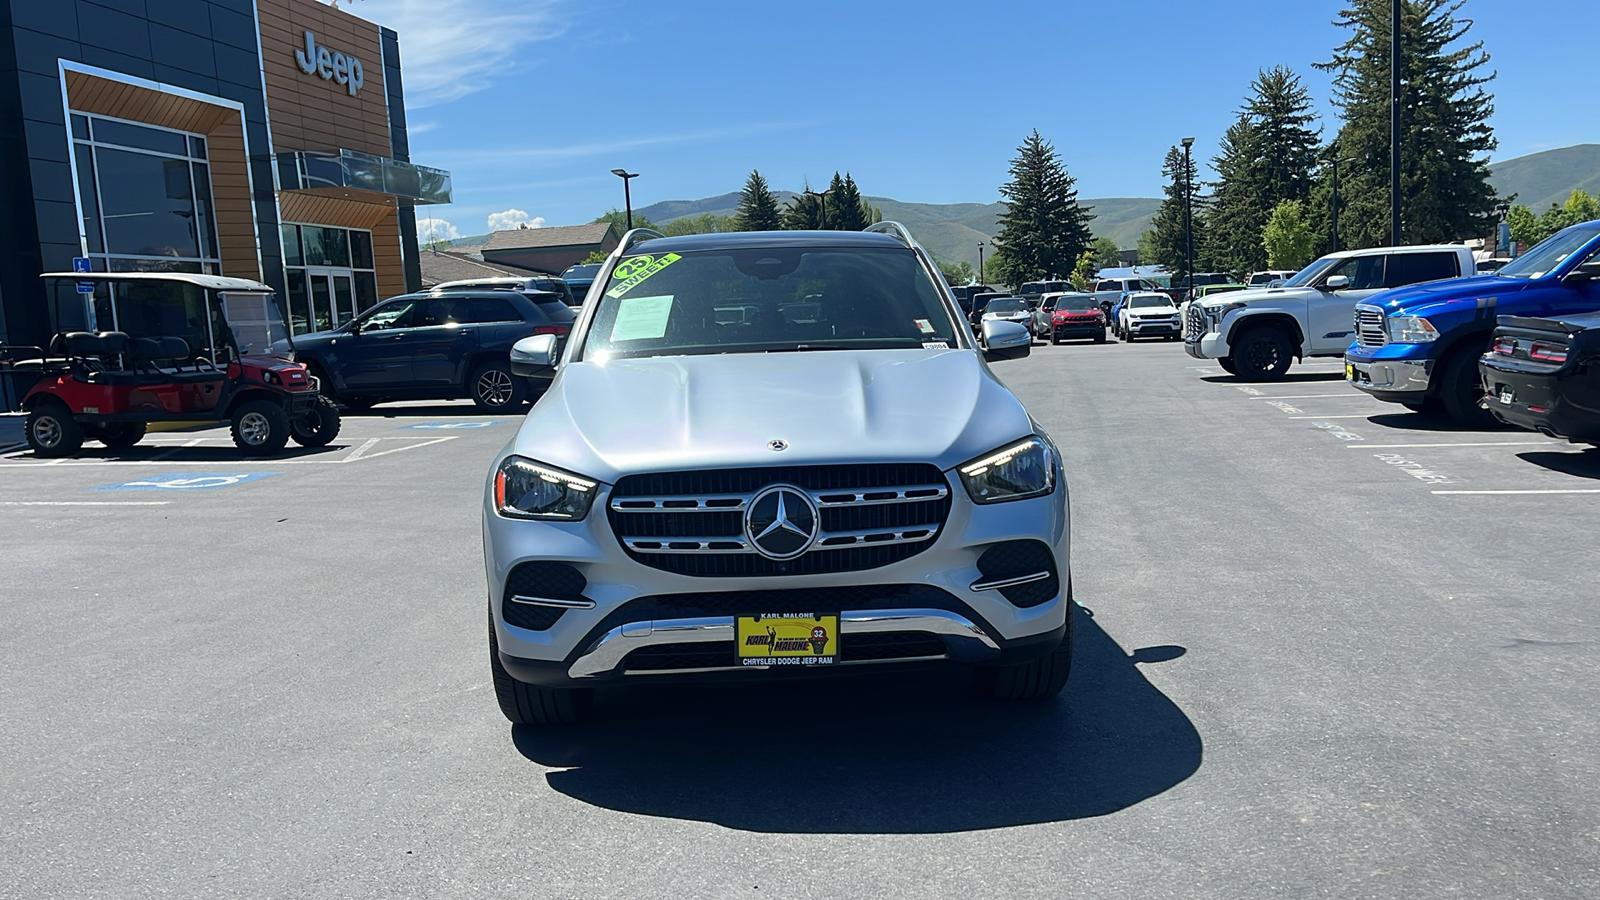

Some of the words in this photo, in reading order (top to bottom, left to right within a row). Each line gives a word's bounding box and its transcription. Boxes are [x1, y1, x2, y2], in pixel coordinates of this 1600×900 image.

[294, 30, 364, 96] Jeep
[619, 258, 647, 276] 25
[813, 630, 824, 638] 32
[745, 635, 770, 646] KARL
[774, 640, 810, 651] MALONE
[742, 658, 777, 666] CHRYSLER
[801, 657, 818, 665] JEEP
